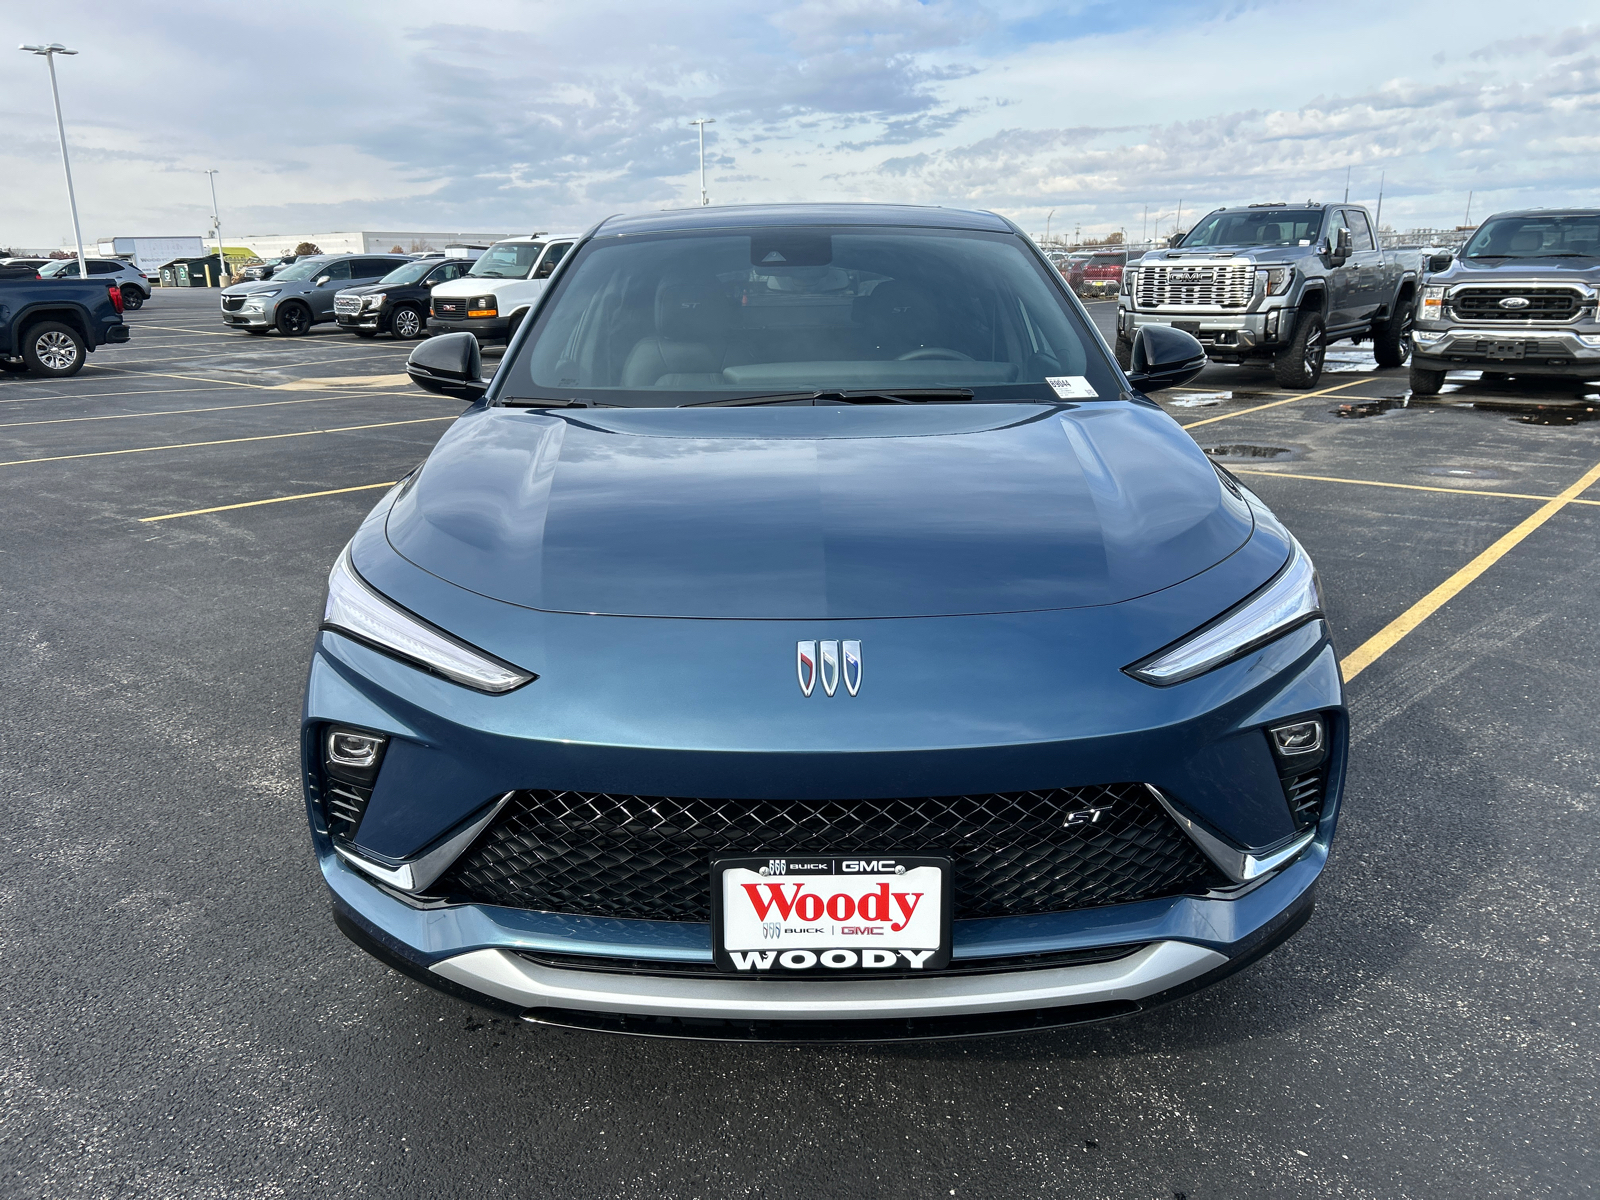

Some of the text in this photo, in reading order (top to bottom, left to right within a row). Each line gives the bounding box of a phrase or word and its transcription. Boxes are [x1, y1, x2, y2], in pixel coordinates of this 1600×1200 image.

[1170, 272, 1213, 282] GMC
[842, 860, 896, 872] GMC
[740, 883, 924, 932] Woody
[841, 926, 884, 936] GMC
[729, 949, 936, 970] WOODY
